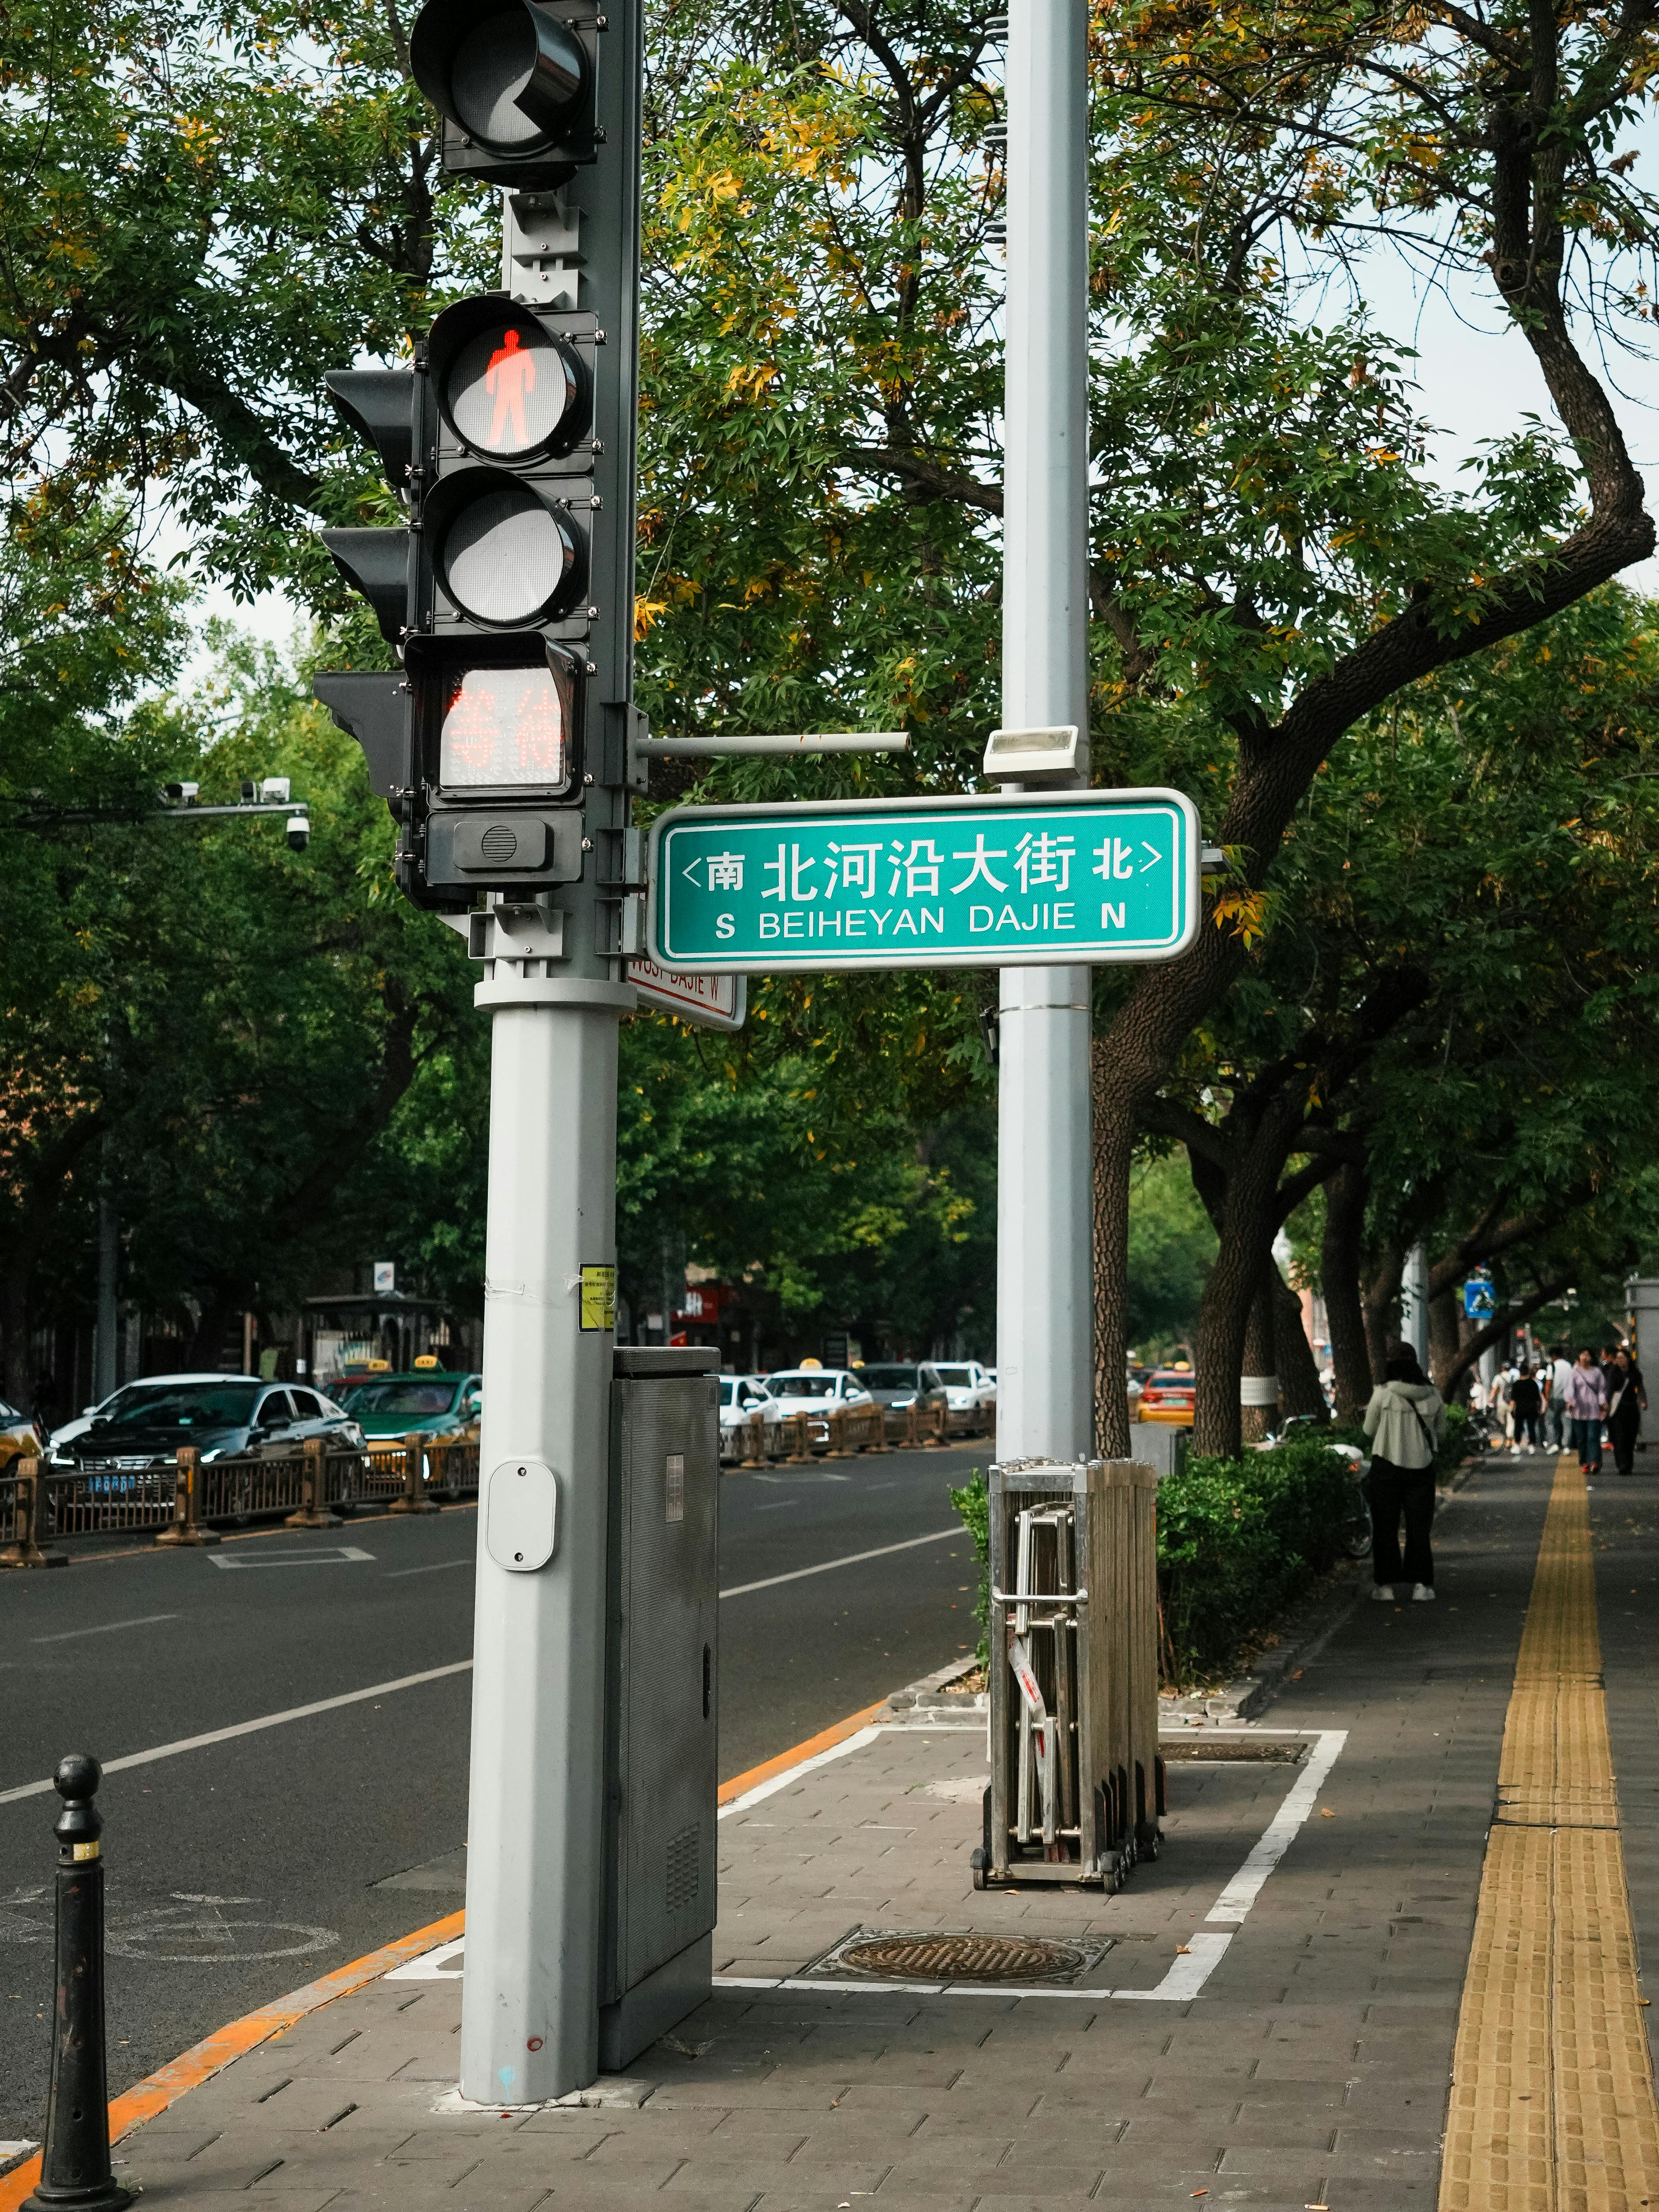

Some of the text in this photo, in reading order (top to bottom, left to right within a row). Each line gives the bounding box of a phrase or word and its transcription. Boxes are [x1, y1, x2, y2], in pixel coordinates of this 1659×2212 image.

[706, 832, 1133, 901] 南 北河沿大街 北
[715, 902, 1126, 939] S BEIHEYAN DAJIE N
[711, 976, 719, 1001] W
